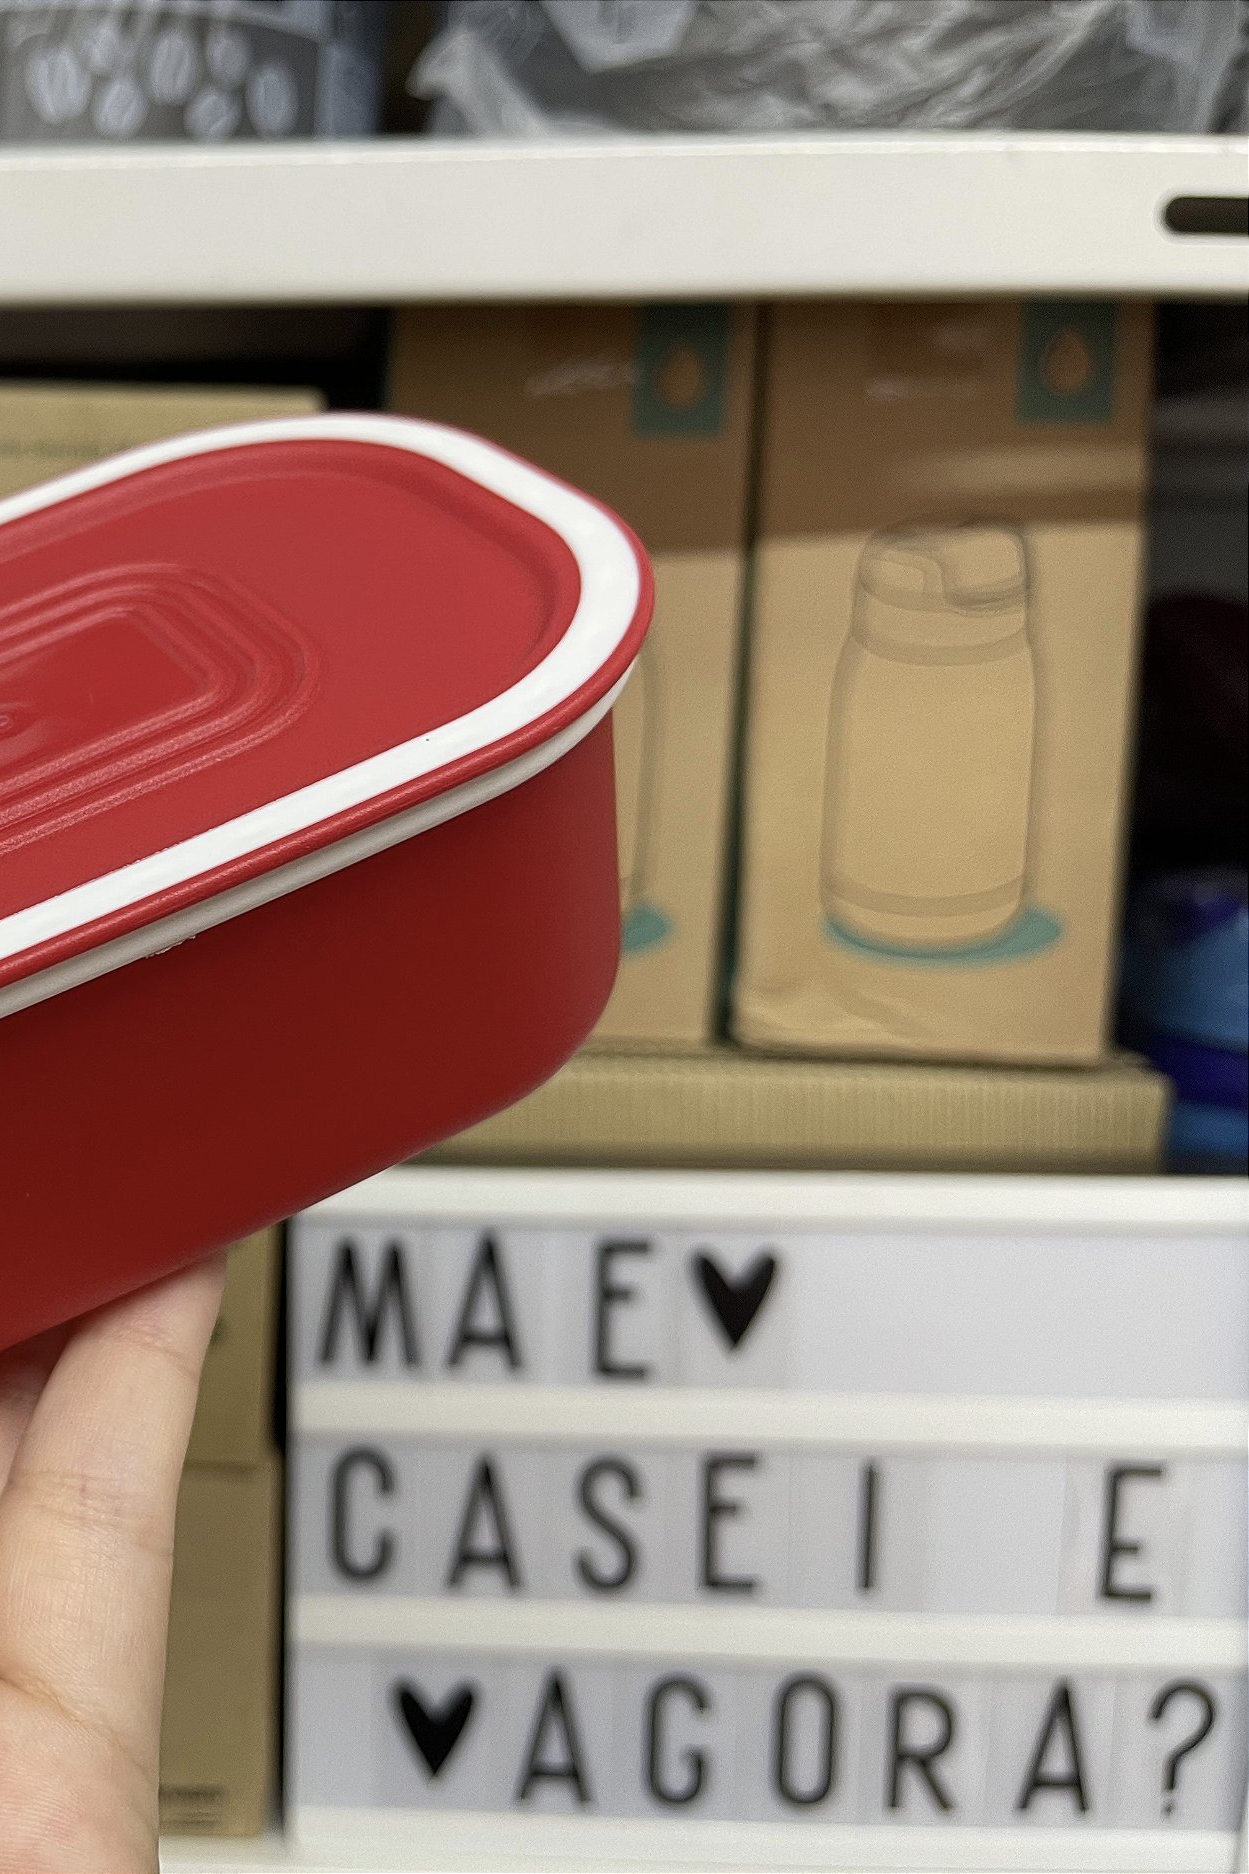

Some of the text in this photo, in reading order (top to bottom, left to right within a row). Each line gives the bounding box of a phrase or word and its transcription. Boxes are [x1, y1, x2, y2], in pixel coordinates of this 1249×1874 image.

[318, 1233, 656, 1381] MAE
[325, 1444, 1167, 1603] CASEI E
[515, 1666, 1220, 1816] AGORA?
